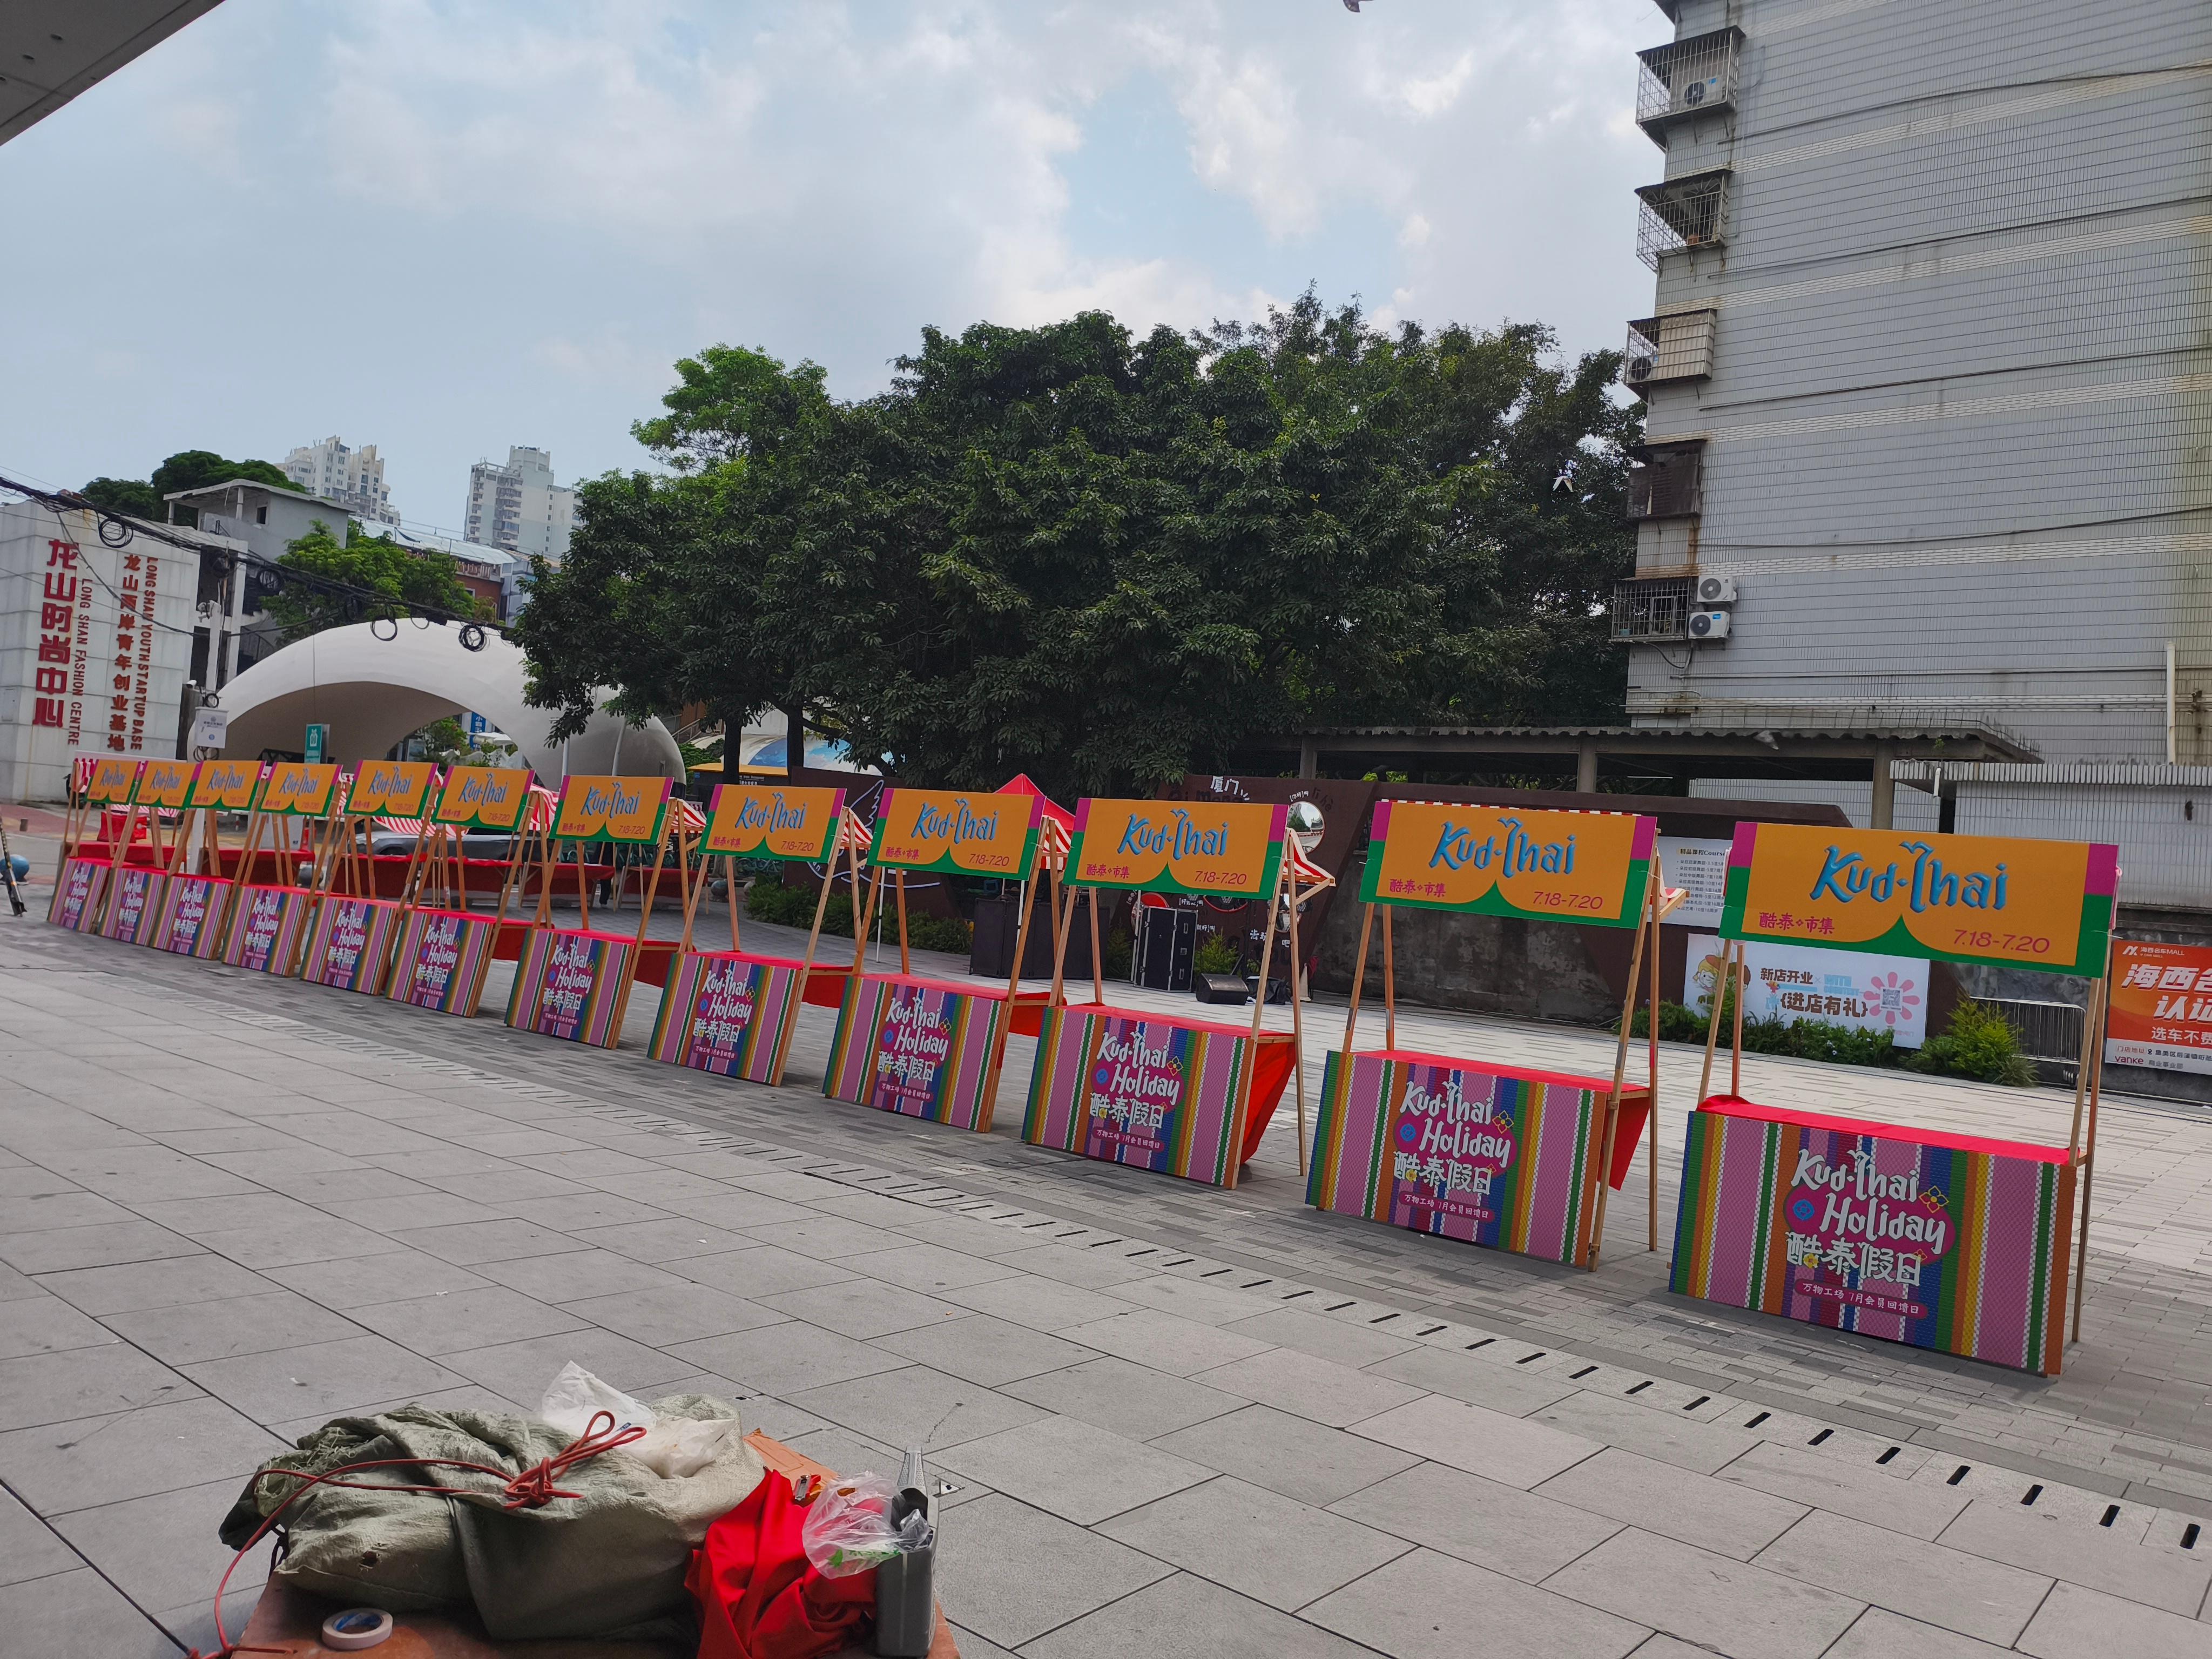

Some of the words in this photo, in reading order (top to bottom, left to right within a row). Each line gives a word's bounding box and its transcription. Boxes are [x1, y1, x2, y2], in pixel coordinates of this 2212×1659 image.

[145, 557, 158, 588] LONG
[80, 578, 92, 609] LONG
[32, 539, 79, 728] 龙山时尚中心
[77, 614, 90, 645] SHAN
[139, 624, 152, 662] YOUTH
[72, 650, 86, 696] FASHION
[68, 702, 82, 745] CENTRE
[130, 719, 144, 750] BASE
[1210, 775, 1239, 795] 厦门
[969, 853, 1009, 867] 7.18-7.20
[1195, 871, 1247, 886] 7.18-7.20
[1533, 891, 1603, 910] 7.18-7.20
[427, 945, 458, 969] Holiday
[1954, 929, 2050, 955] 7.18-7.20
[555, 966, 592, 994] Holiday
[1760, 968, 1813, 984] 新店开业
[707, 994, 752, 1024] Holiday
[894, 1025, 948, 1061] Holiday
[2117, 1045, 2145, 1054] 门店地址
[1109, 1063, 1181, 1106] Holiday
[1090, 1091, 1164, 1129] 酷泰假日
[1419, 1117, 1511, 1168] Holiday
[1393, 1150, 1493, 1196] 酷泰假日
[1404, 1194, 1435, 1207] 万物工场
[1819, 1192, 1946, 1255] Holiday
[1785, 1231, 1924, 1286] 酷泰假日
[1803, 1283, 1844, 1299] 万物工场
[1849, 1292, 1919, 1314] 7月会员回馈日
